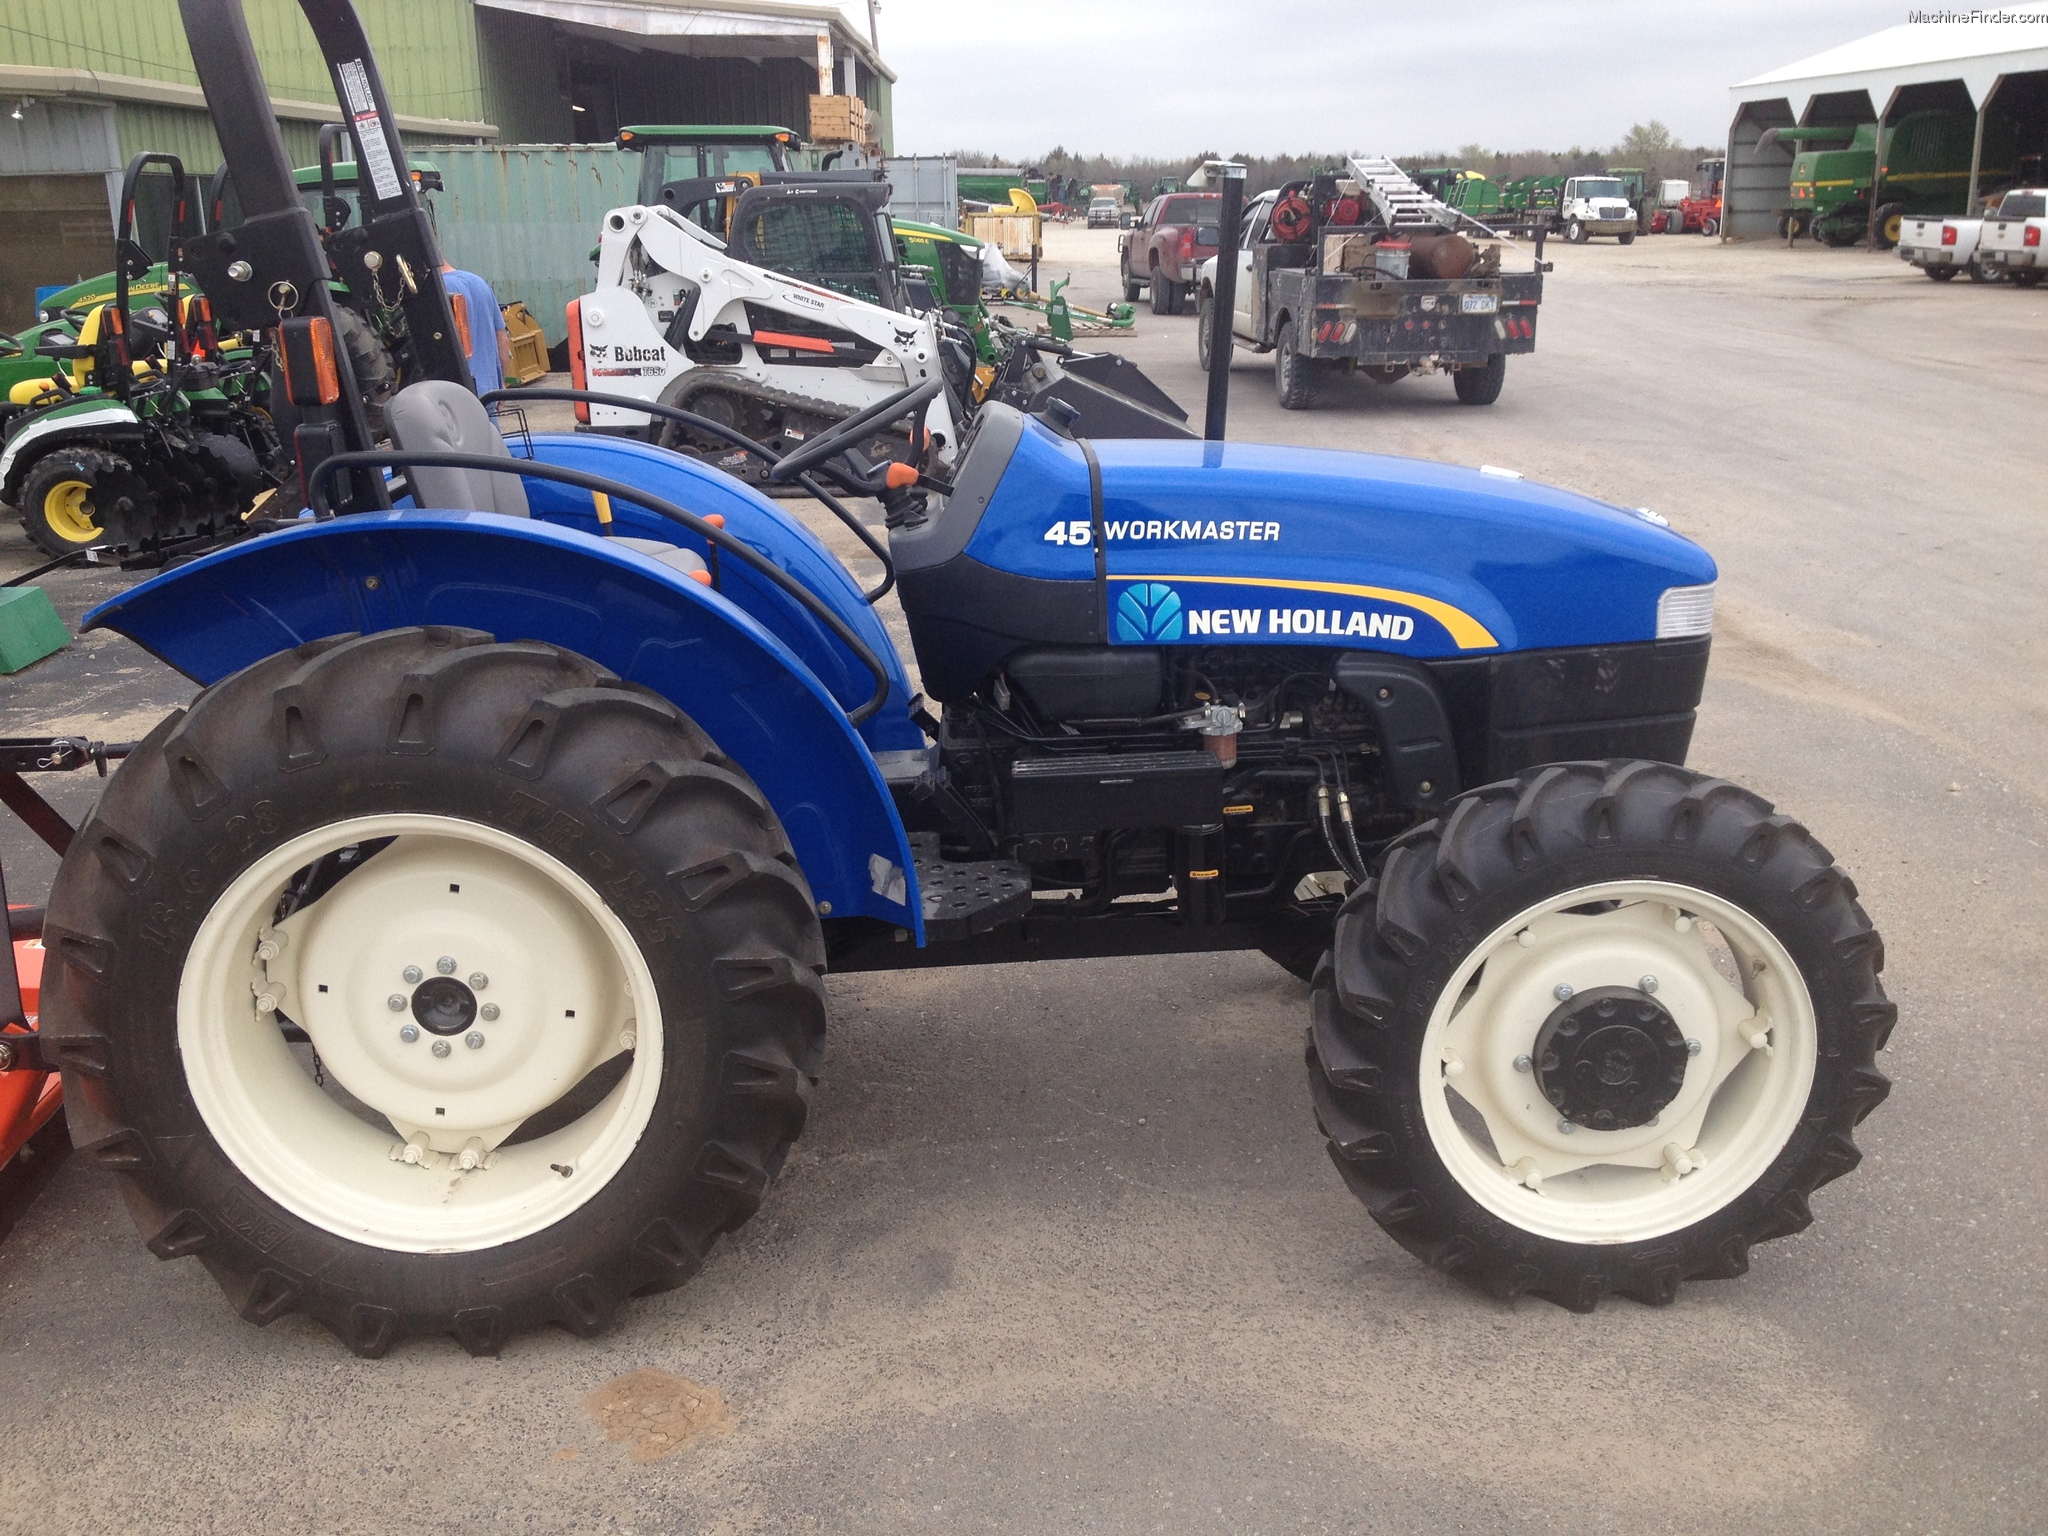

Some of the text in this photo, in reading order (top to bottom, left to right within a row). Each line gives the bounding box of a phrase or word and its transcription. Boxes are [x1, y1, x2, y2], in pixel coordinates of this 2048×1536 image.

[793, 293, 825, 309] WHITE STAR
[614, 346, 666, 362] Bobcat
[1043, 520, 1281, 545] 45 WORKMASTER
[1188, 609, 1415, 641] NEW HOLLAND
